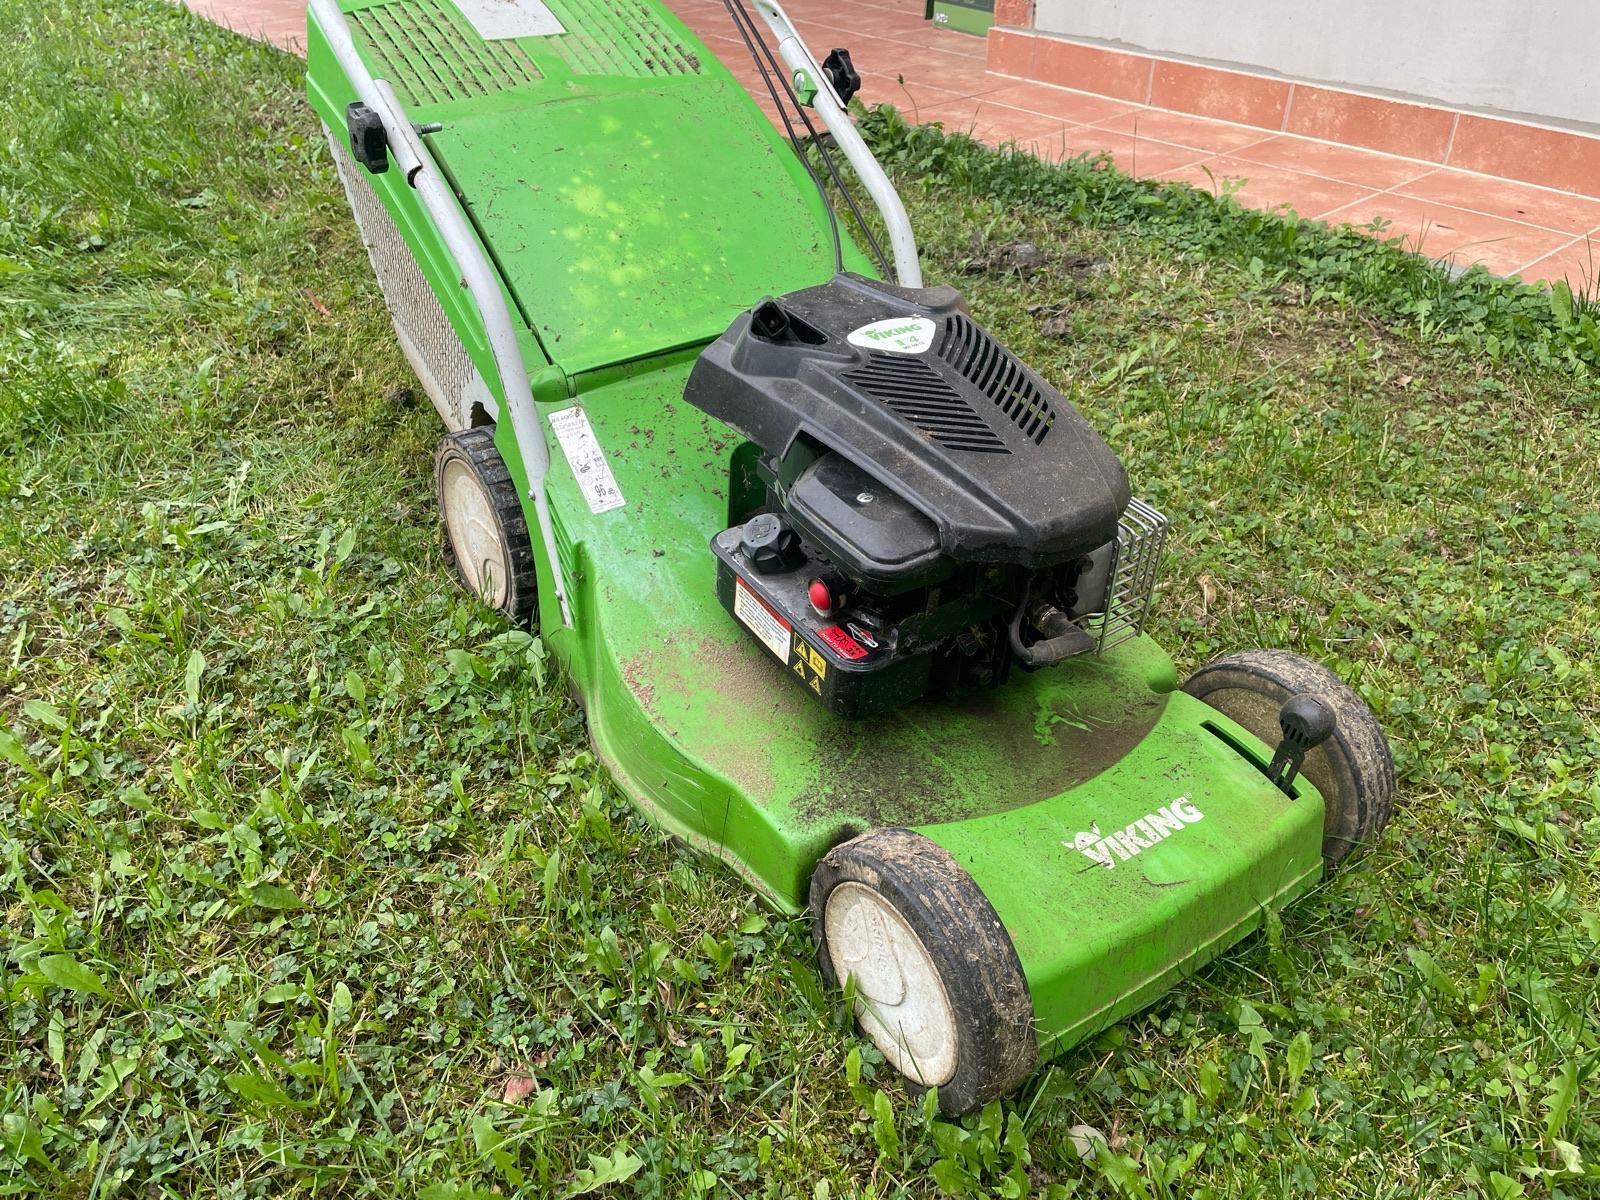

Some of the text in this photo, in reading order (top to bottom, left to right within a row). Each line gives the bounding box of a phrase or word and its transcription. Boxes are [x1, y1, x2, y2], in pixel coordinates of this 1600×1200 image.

[866, 324, 922, 340] VIKING
[594, 484, 607, 497] 96
[1080, 796, 1205, 870] VIKING
